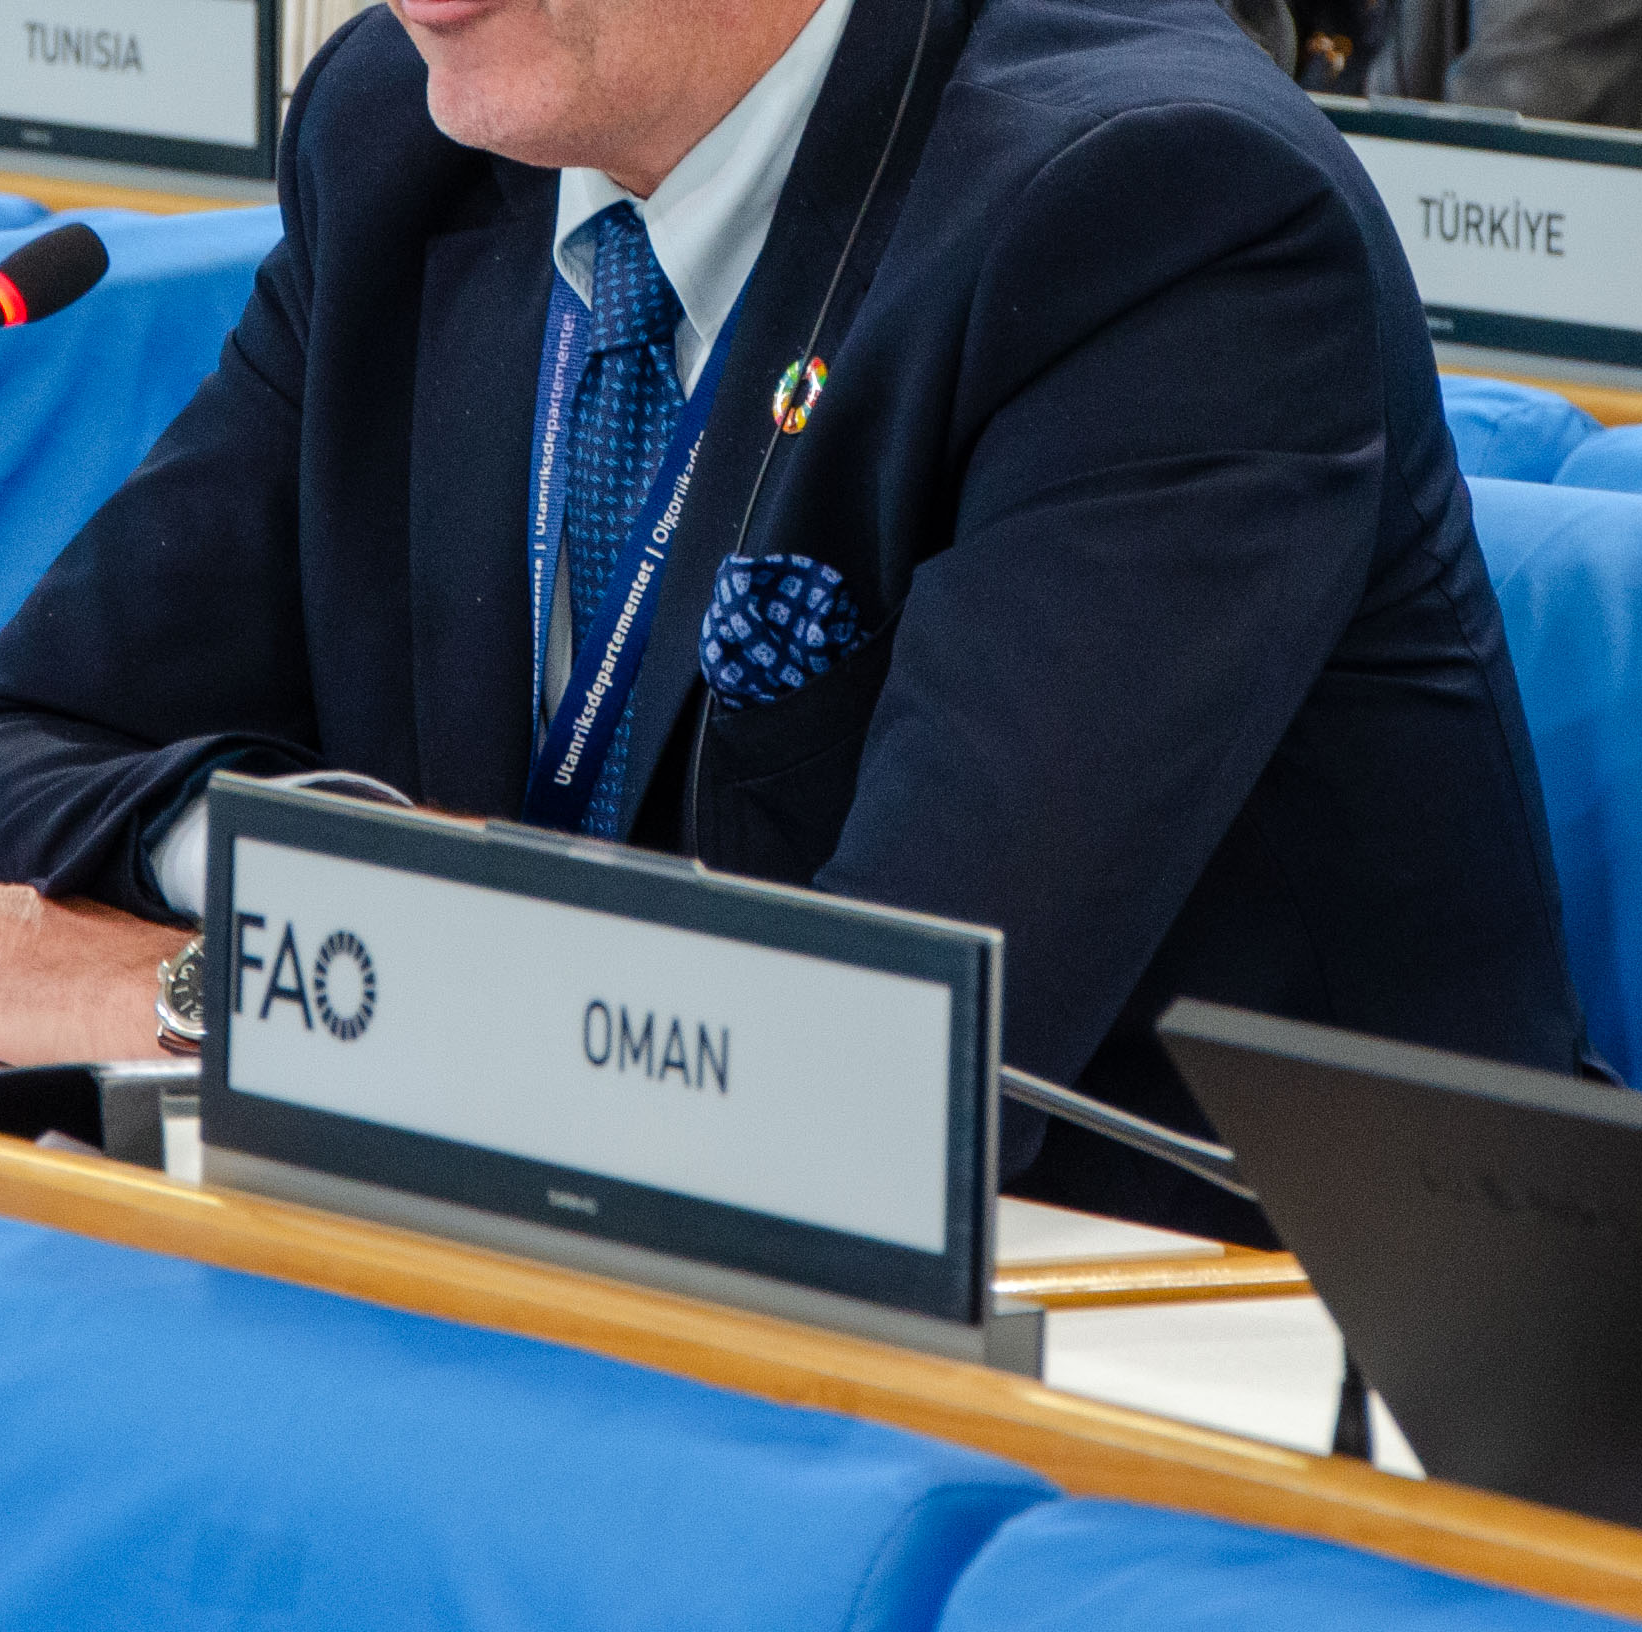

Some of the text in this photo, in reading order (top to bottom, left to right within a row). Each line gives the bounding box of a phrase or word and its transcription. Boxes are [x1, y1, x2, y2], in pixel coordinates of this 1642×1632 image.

[24, 21, 145, 74] TUNISIA
[1417, 190, 1567, 258] TÜRKİYE
[553, 557, 656, 786] Utanriksdepartementet
[231, 910, 378, 1043] FAO
[583, 998, 732, 1095] OMAN
